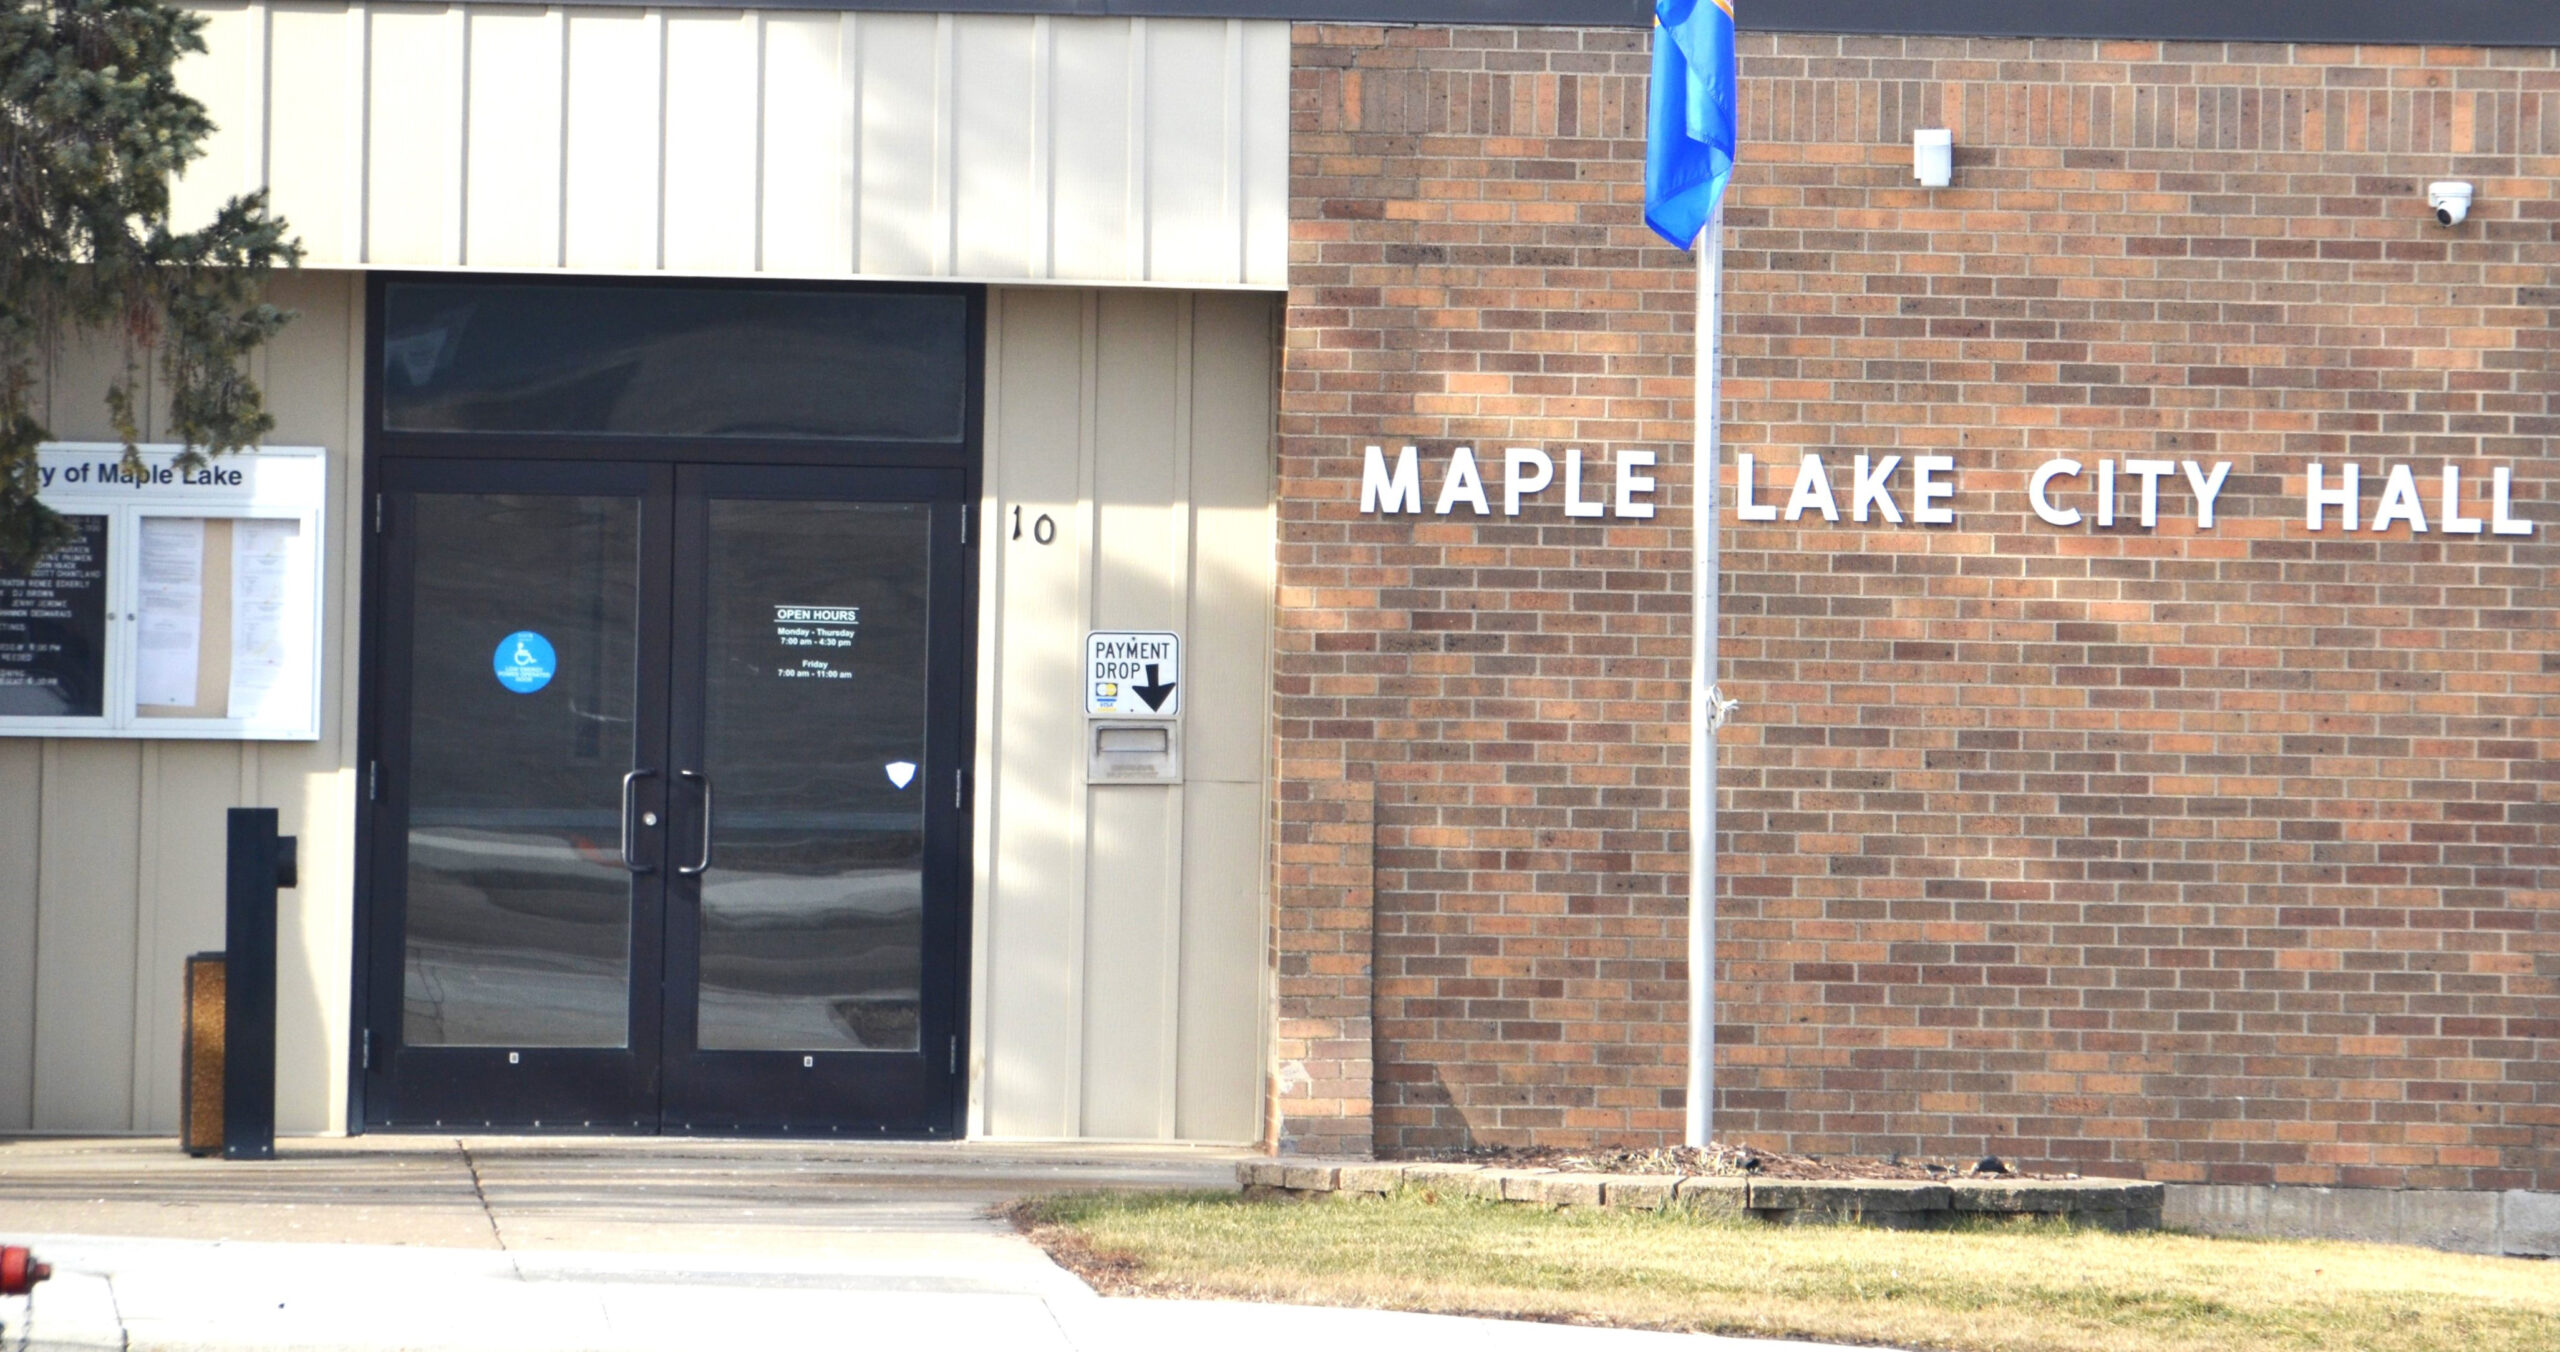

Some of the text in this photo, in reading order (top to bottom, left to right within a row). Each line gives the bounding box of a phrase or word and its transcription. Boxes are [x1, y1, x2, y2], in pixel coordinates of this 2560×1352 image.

[65, 462, 90, 483] of
[98, 463, 173, 489] Maple
[183, 465, 242, 486] Lake
[1360, 446, 2533, 535] MAPLE LAKE CITY HALL
[1012, 504, 1056, 545] 10
[777, 609, 856, 621] OPEN HOURS
[777, 627, 810, 637] Monday
[816, 628, 855, 638] Thursday
[781, 637, 798, 645] 7:00
[819, 638, 836, 646] 4:30
[1096, 642, 1170, 659] PAYMENT
[802, 660, 828, 669] Friday
[1096, 662, 1140, 679] DROP
[778, 669, 795, 677] 7:00
[817, 670, 838, 678] 11:00
